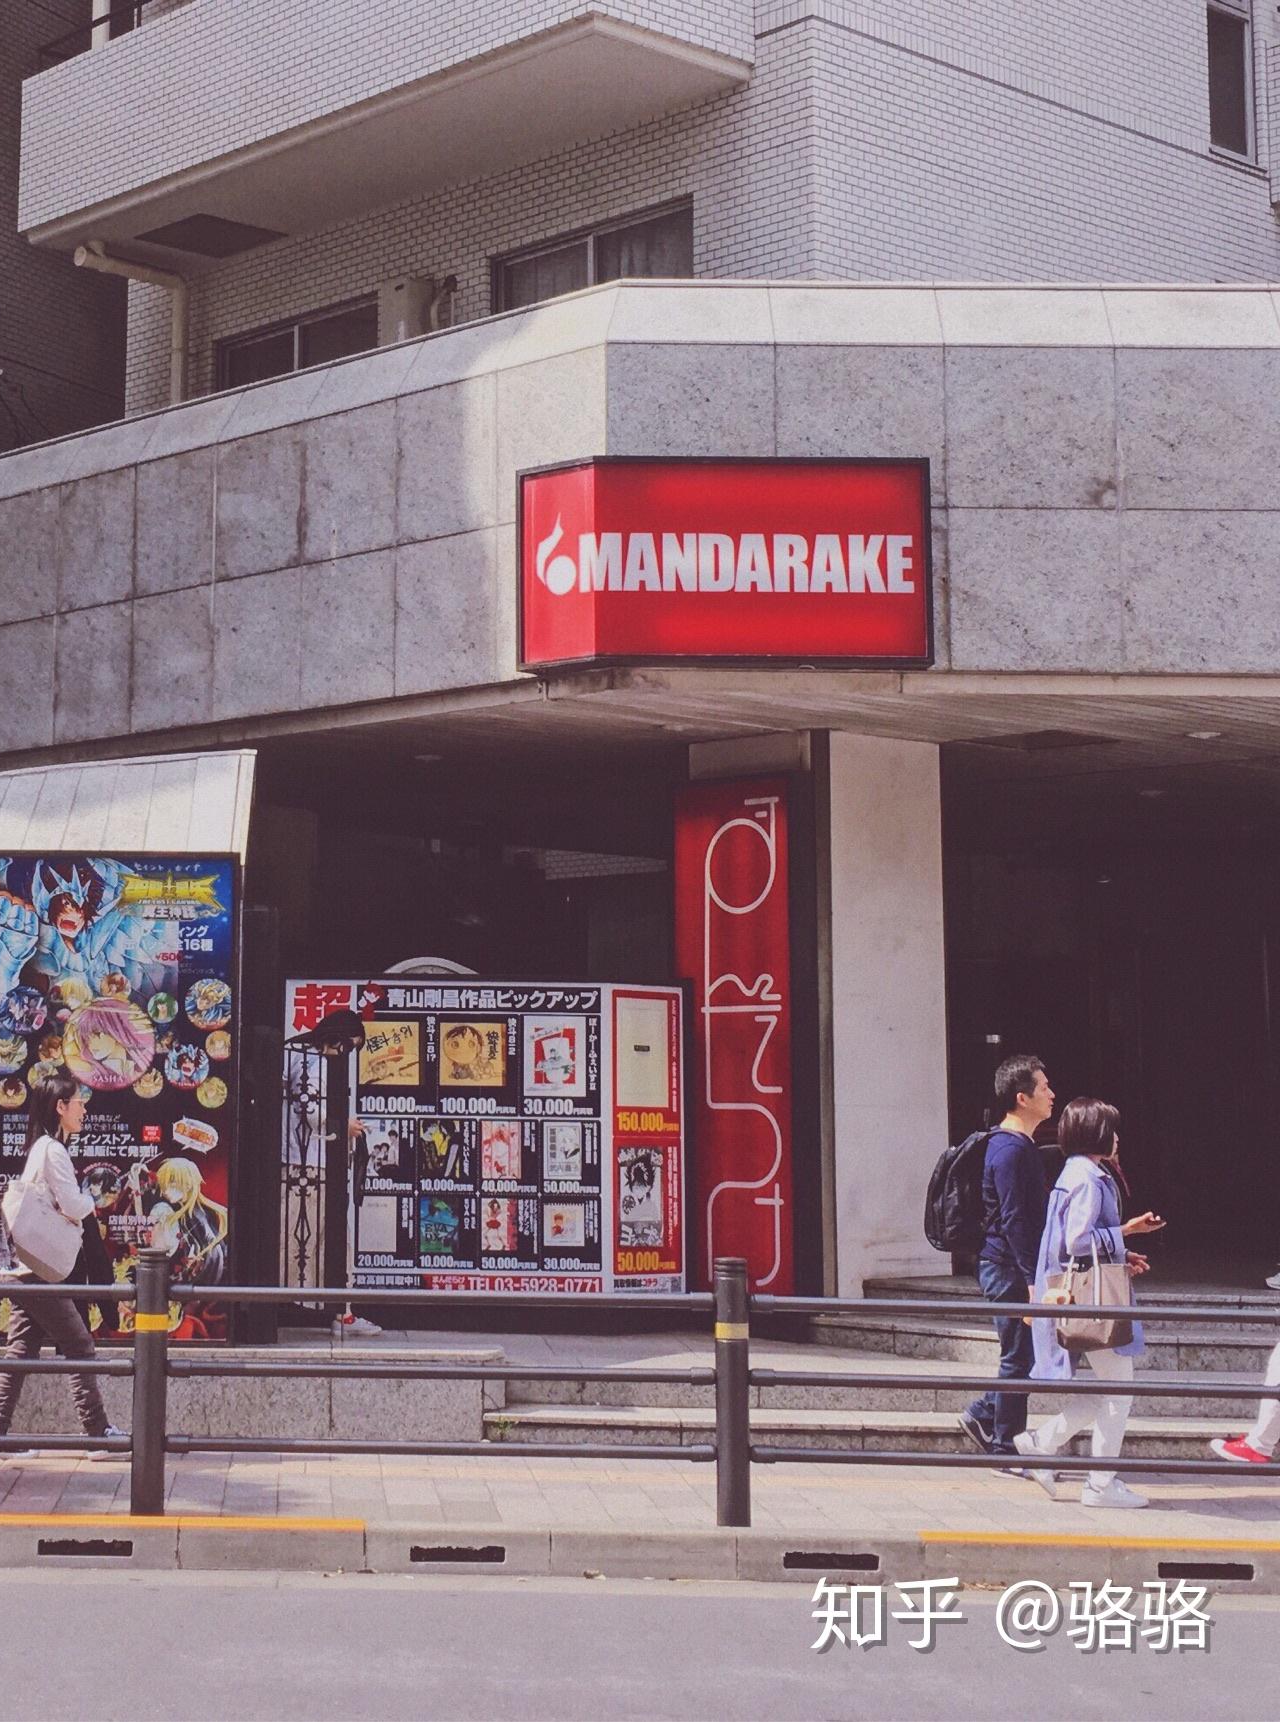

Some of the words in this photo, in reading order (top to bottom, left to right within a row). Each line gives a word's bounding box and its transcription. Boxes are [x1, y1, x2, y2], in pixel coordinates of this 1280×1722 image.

[578, 532, 915, 594] MANDARAKE
[388, 989, 598, 1009] 青山剛昌作品ピックアップ
